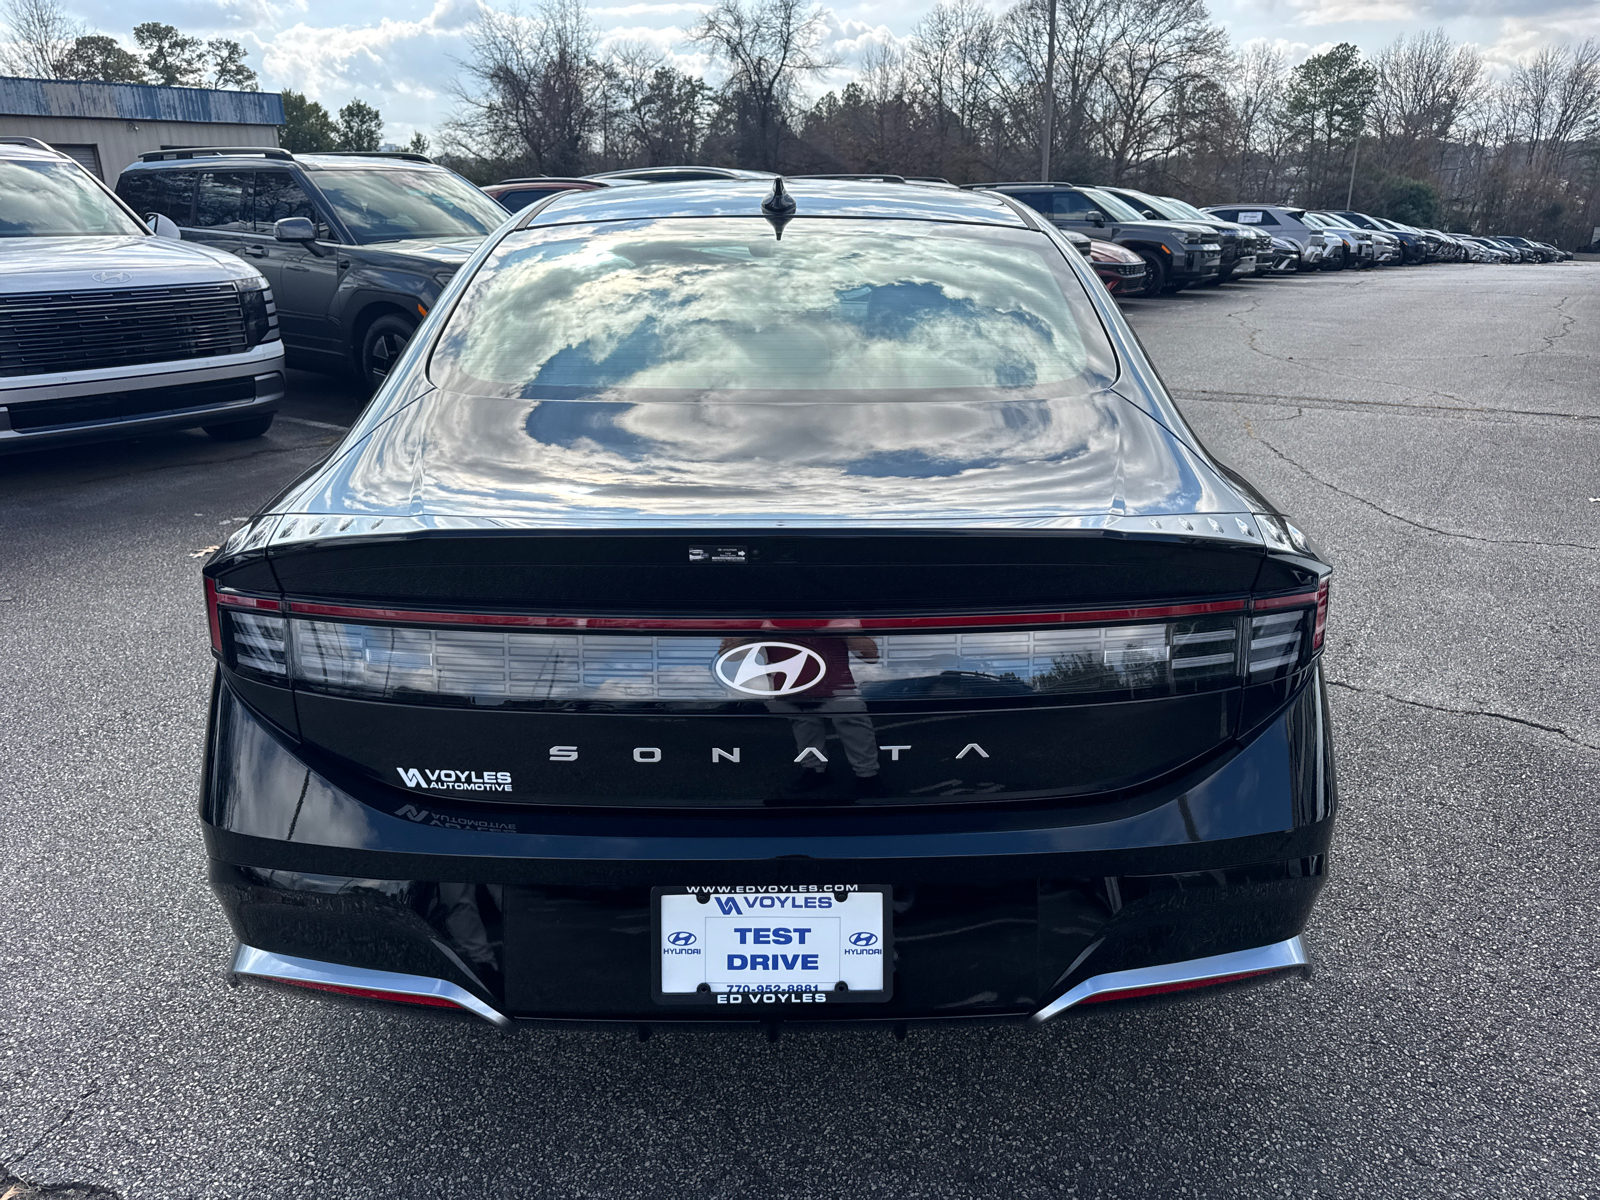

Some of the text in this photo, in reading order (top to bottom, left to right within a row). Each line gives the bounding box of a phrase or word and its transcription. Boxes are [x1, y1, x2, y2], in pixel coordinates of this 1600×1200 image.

[549, 743, 990, 764] SONATA
[425, 768, 512, 784] VOYLES
[429, 782, 513, 791] AUTOMOTIVE
[686, 884, 858, 893] WWW.EDVOYLES.COM
[743, 896, 833, 909] VOYLES
[734, 927, 811, 945] TEST
[727, 954, 819, 970] DRIVE
[726, 984, 818, 993] 770-952-8881
[717, 993, 827, 1004] ED VOYLES
